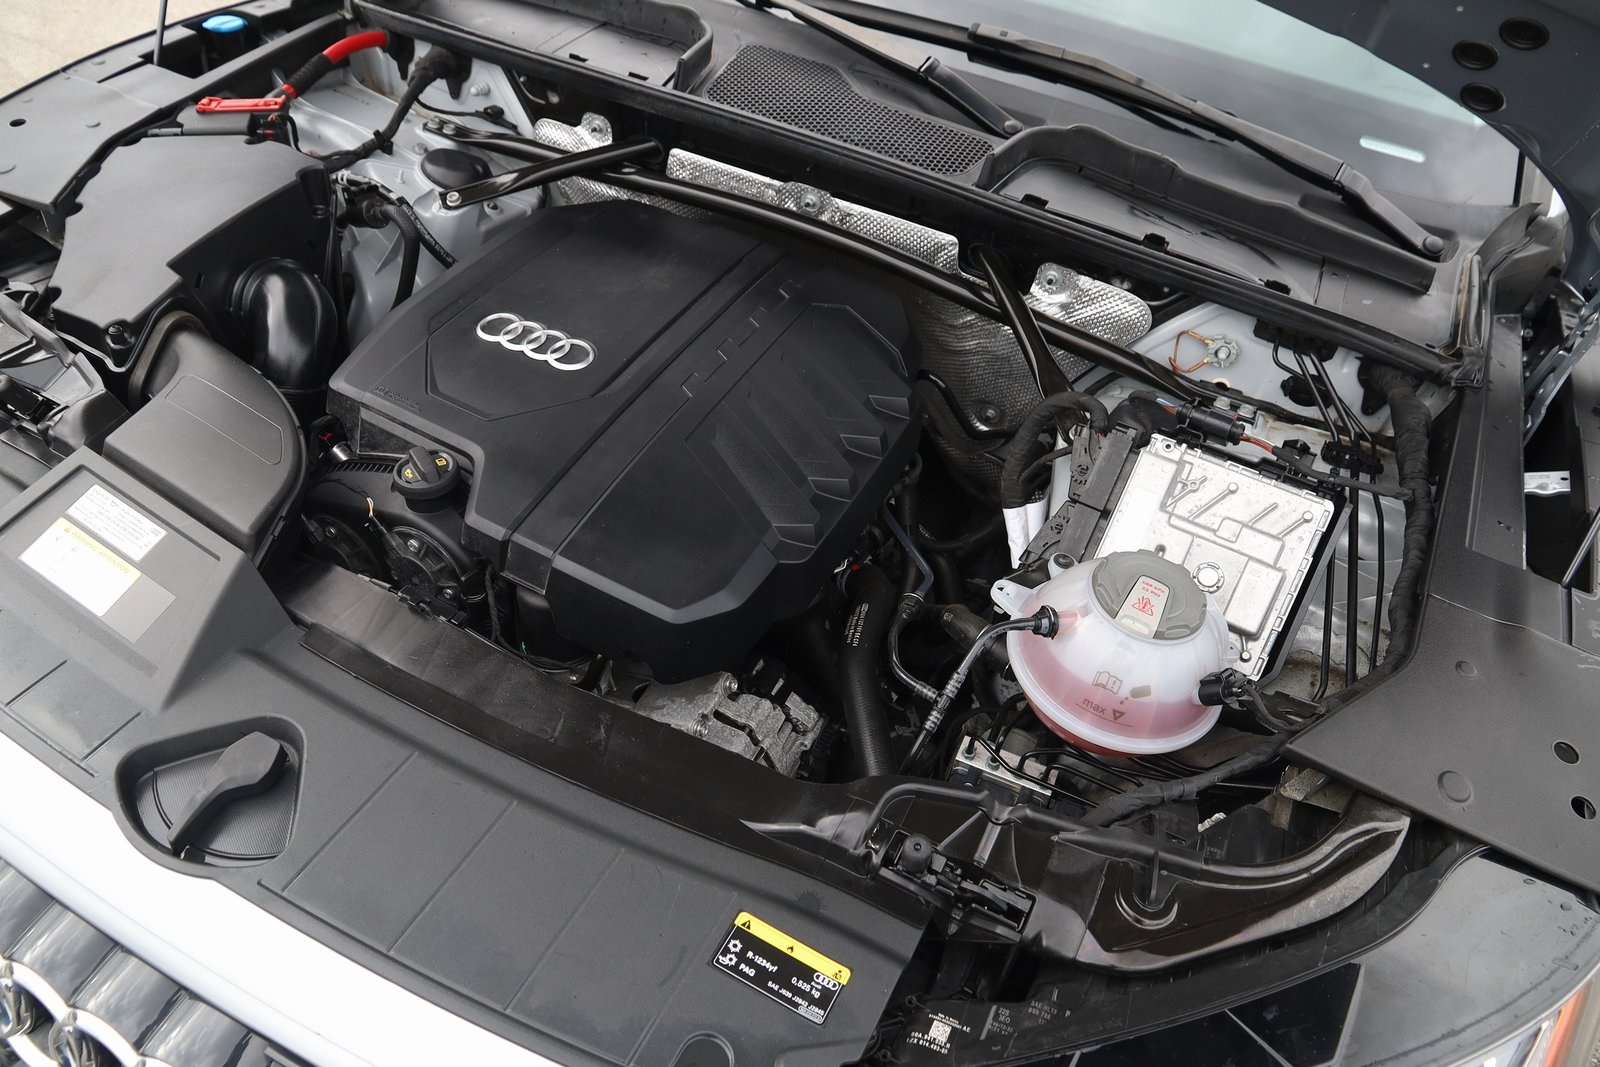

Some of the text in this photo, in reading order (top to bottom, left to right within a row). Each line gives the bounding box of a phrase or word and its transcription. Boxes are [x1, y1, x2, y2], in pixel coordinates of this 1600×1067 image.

[1082, 698, 1106, 715] max
[738, 962, 756, 977] PAG
[746, 950, 778, 973] R-1234yf
[767, 980, 779, 992] SAE
[791, 976, 821, 999] 0,525 kg
